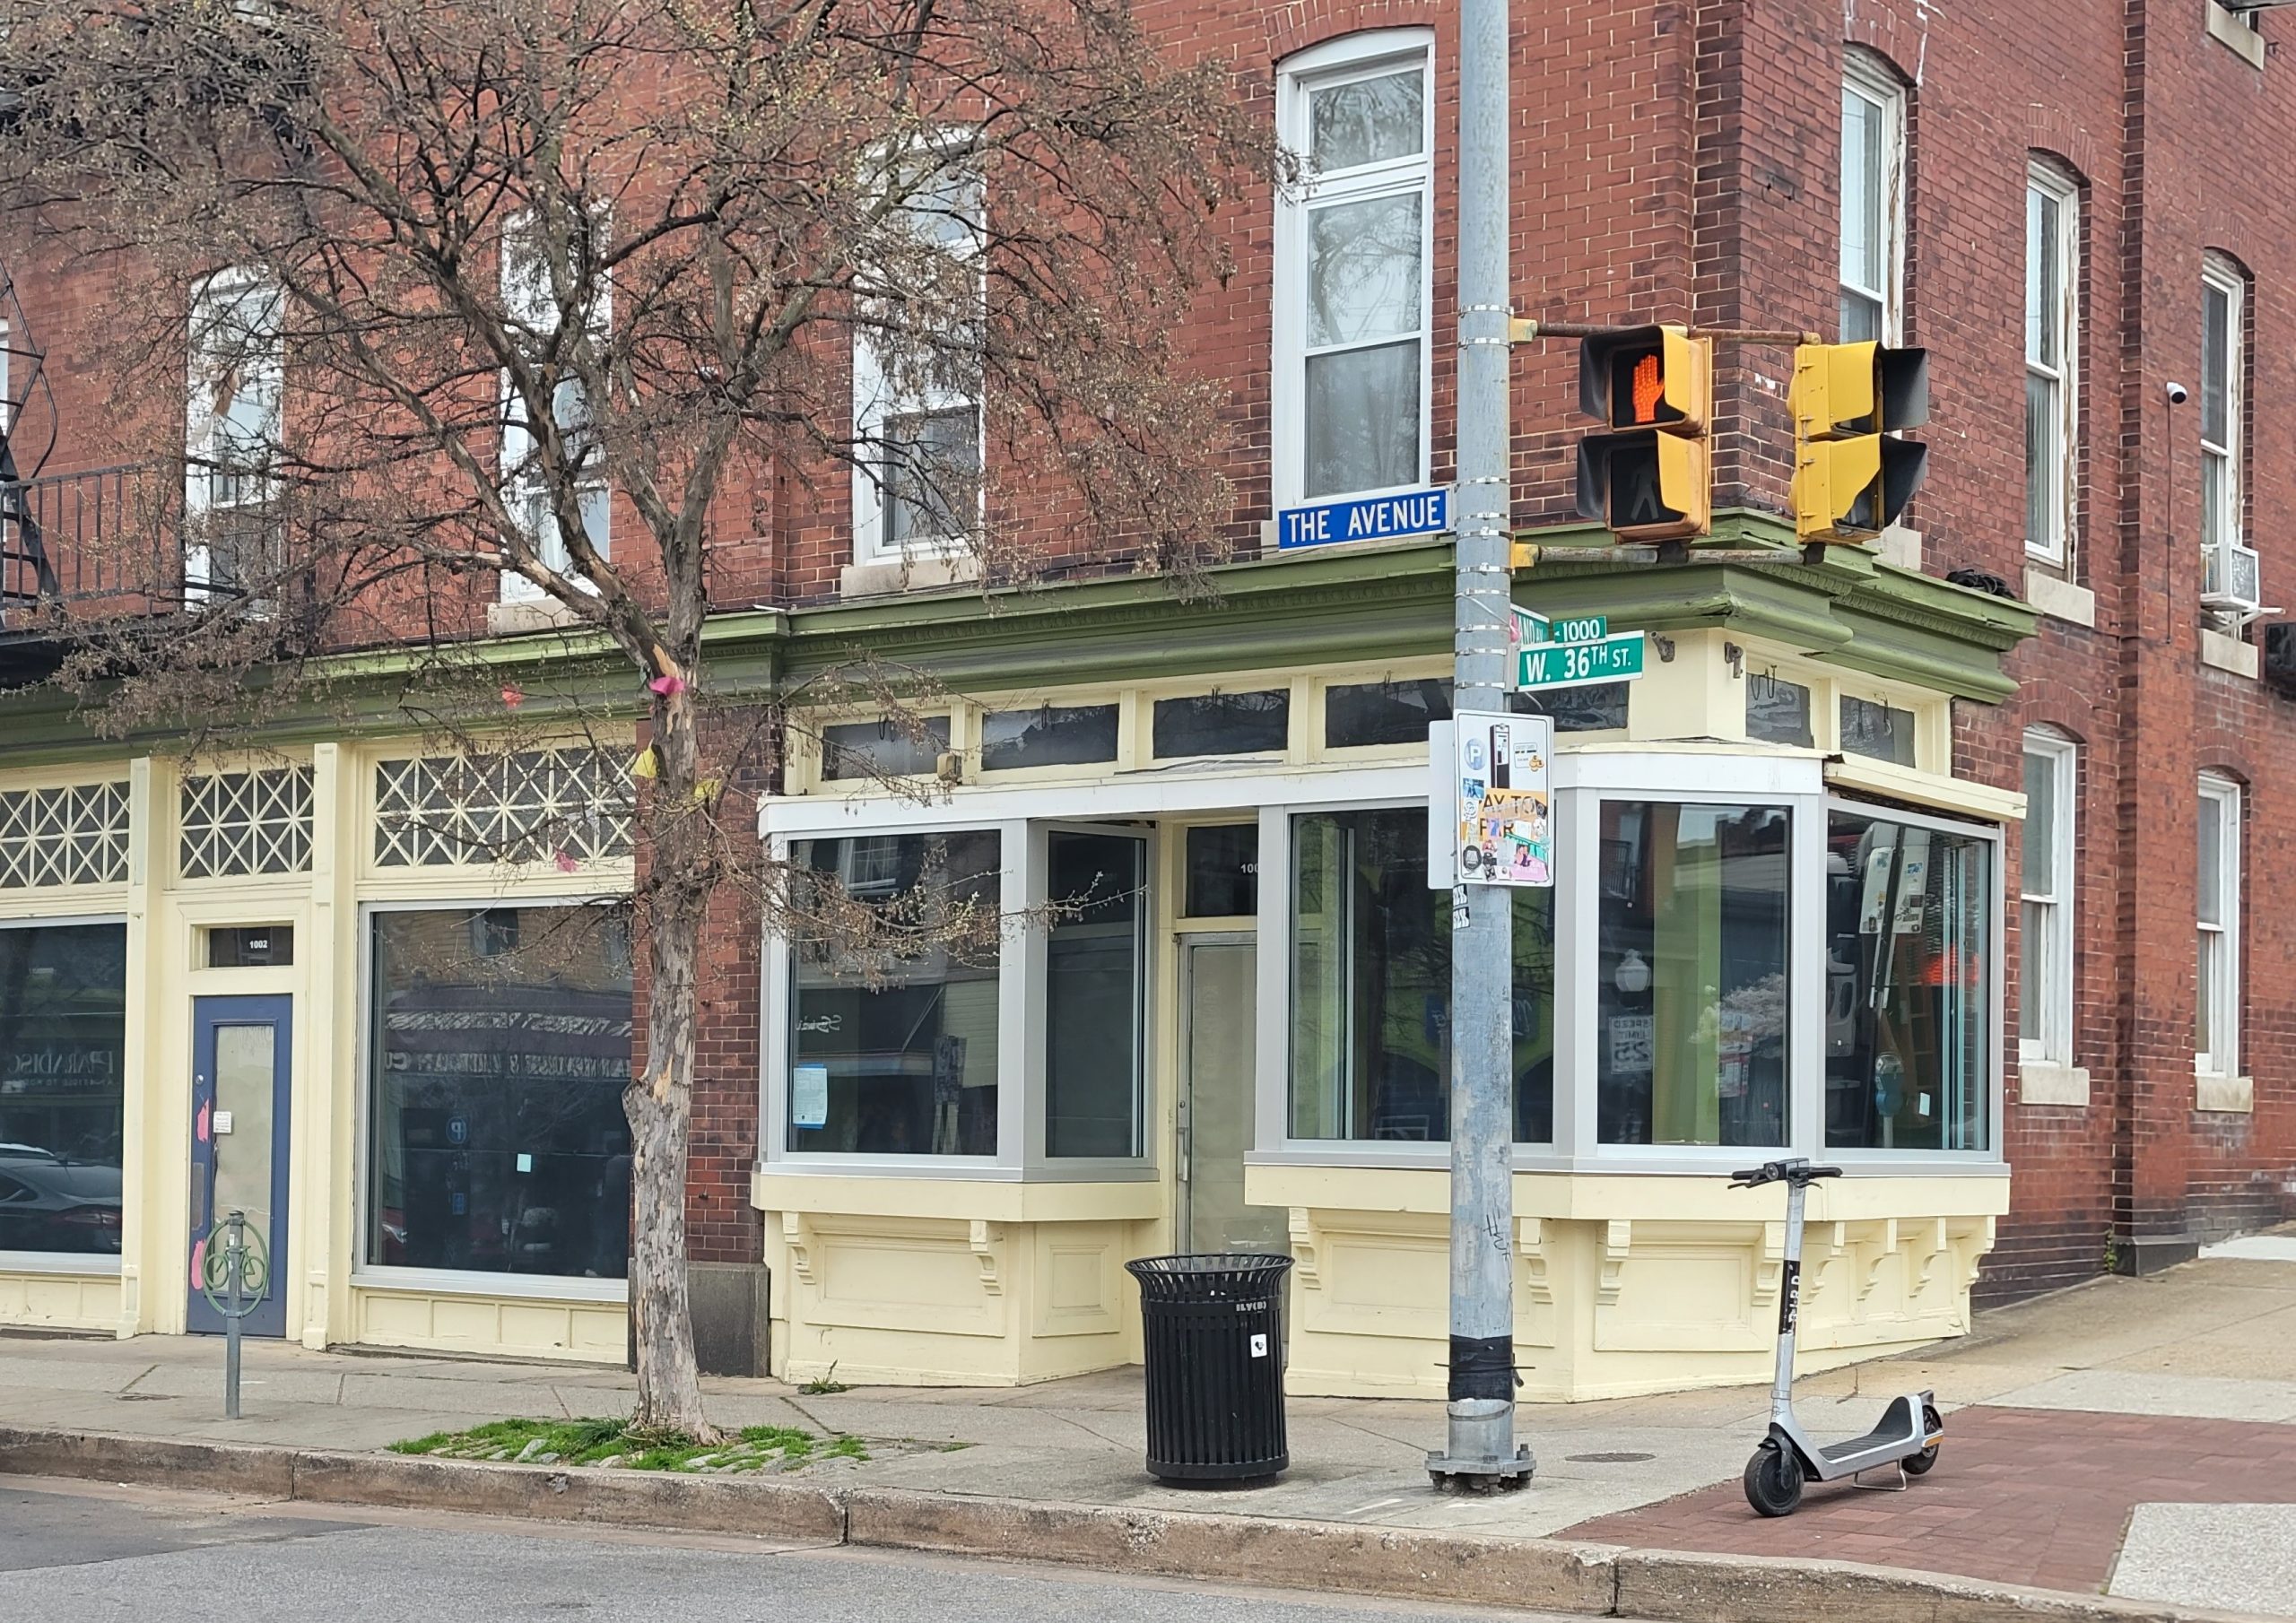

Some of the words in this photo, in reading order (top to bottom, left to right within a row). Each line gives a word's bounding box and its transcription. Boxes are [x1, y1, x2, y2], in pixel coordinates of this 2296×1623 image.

[1287, 509, 1331, 542] THE
[1348, 495, 1441, 536] AVENUE
[1562, 619, 1600, 642] 1000
[1526, 653, 1551, 682] W.
[1612, 648, 1631, 668] ST.
[1478, 794, 1505, 812] AY
[249, 940, 268, 949] 1002
